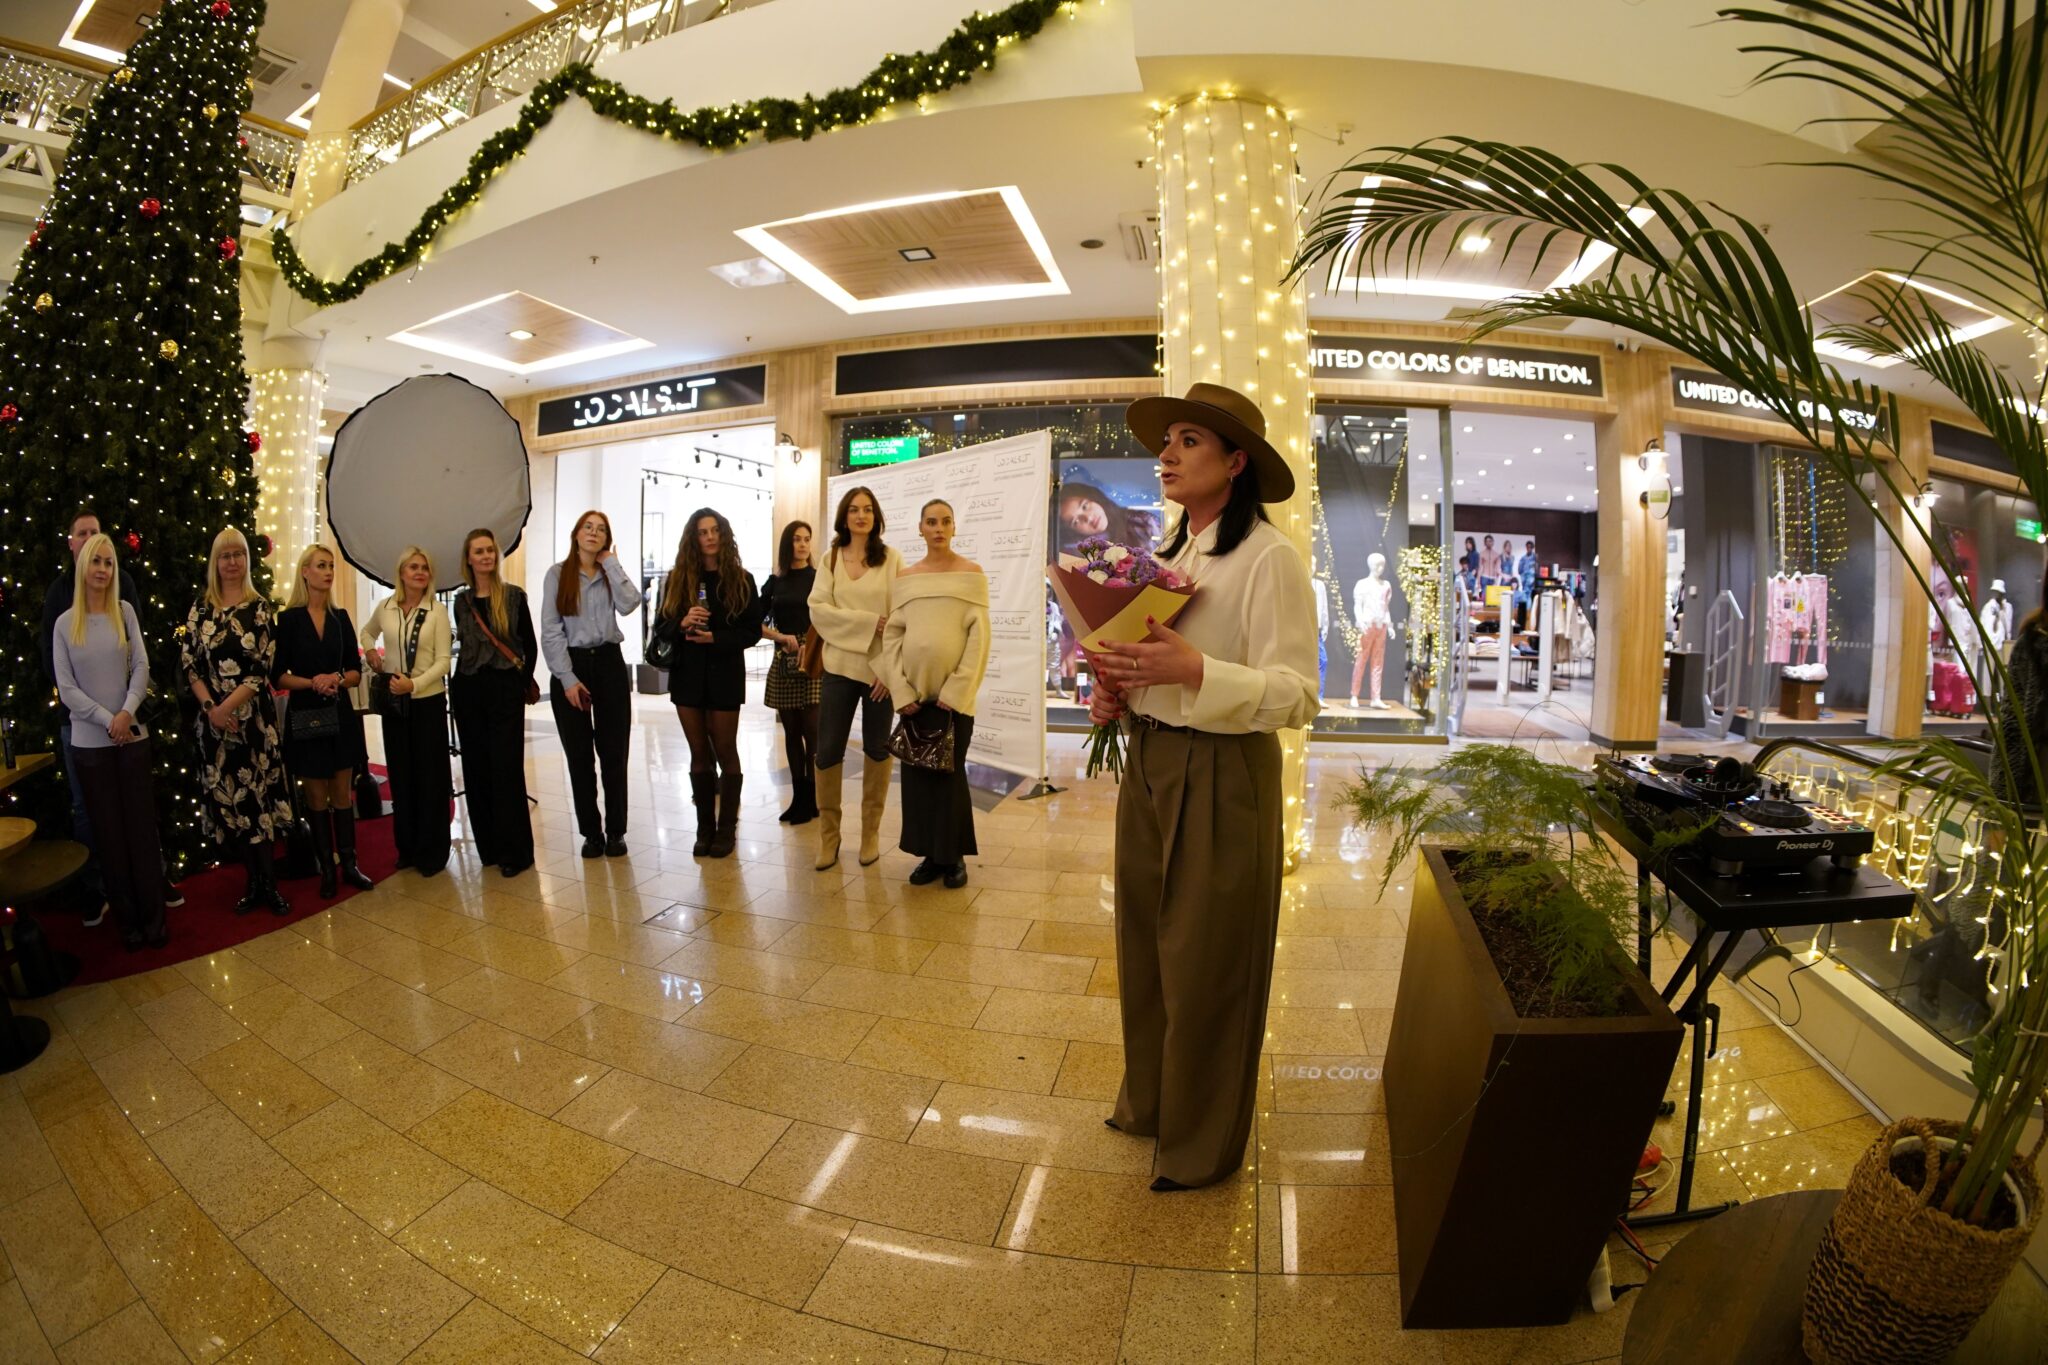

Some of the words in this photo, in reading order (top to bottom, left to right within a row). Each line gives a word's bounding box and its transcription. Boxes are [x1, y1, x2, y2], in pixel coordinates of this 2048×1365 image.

[1307, 348, 1363, 369] NITED
[1367, 350, 1451, 374] COLORS
[1455, 355, 1483, 374] OF
[1487, 358, 1593, 385] BENETTON.
[1679, 380, 1739, 404] UNITED
[1776, 840, 1821, 850] Pioneer
